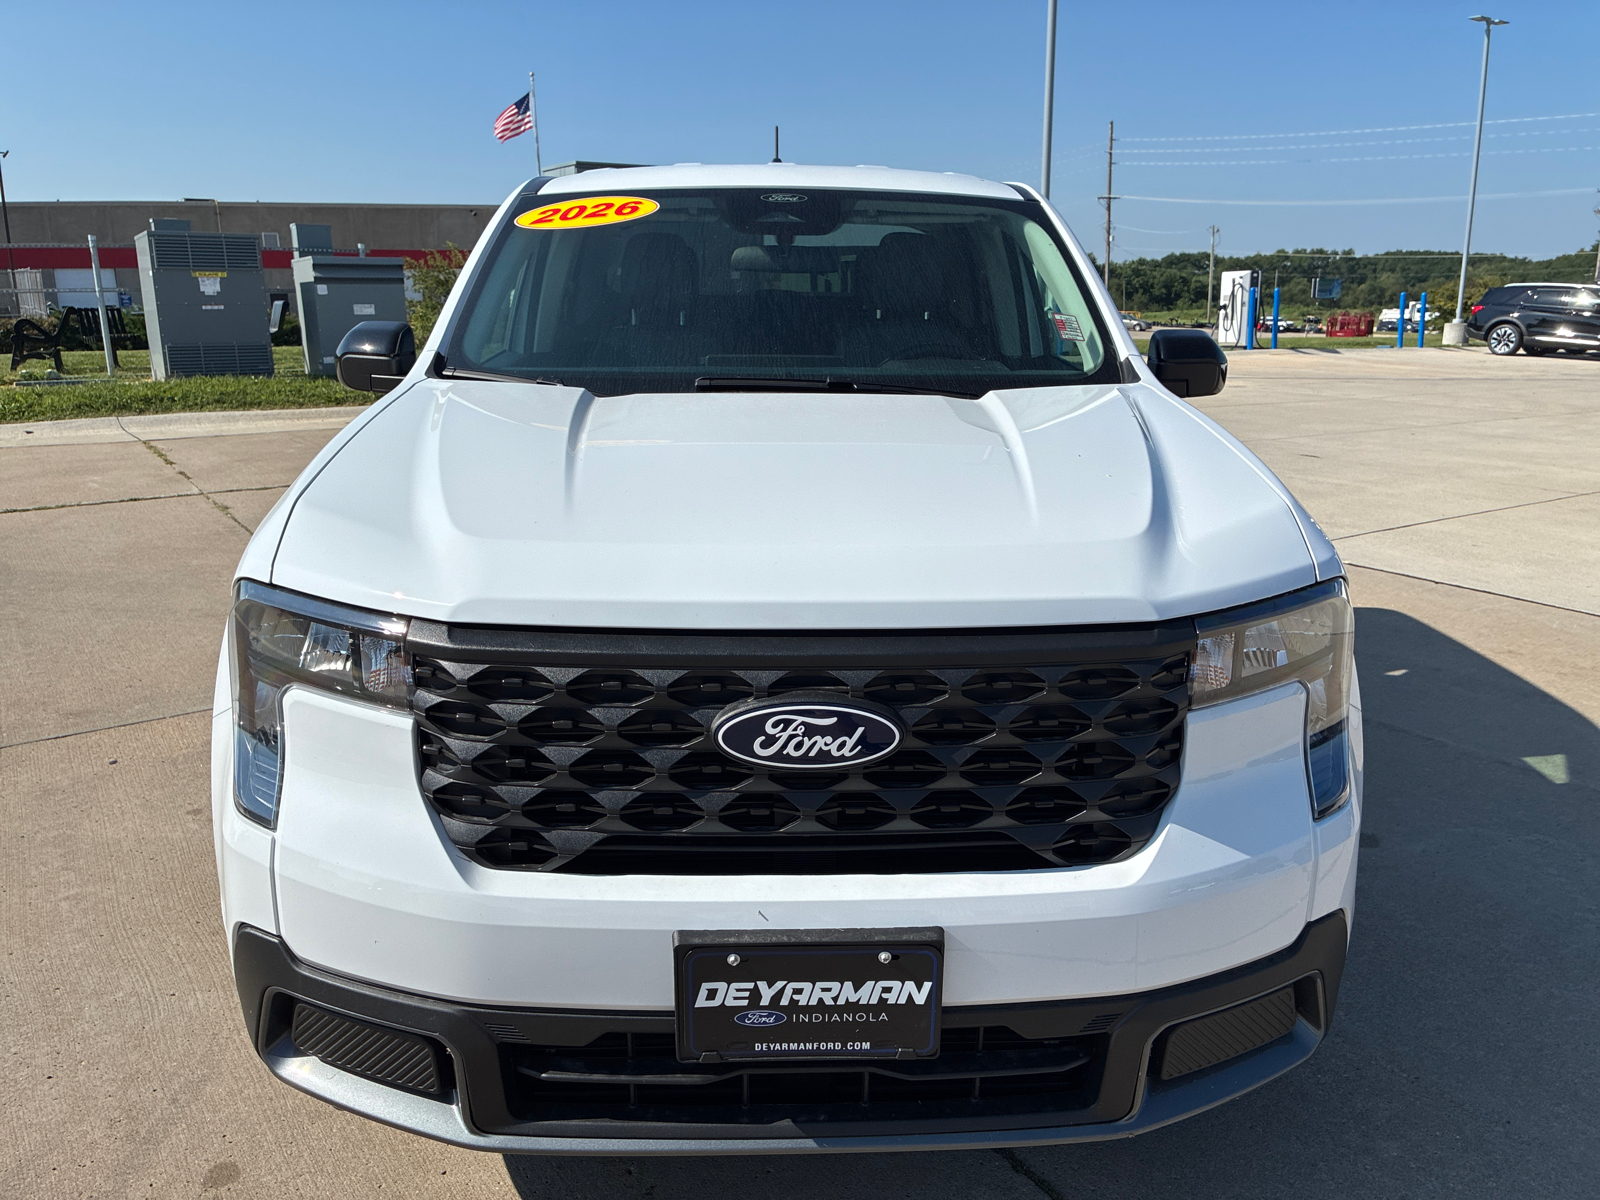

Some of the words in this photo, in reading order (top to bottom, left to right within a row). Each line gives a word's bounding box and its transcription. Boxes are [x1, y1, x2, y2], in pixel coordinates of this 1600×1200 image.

[528, 201, 643, 226] 2026
[753, 714, 865, 757] Ford
[694, 980, 933, 1008] DEYARMAN
[744, 1012, 777, 1025] Ford
[792, 1012, 889, 1023] INDIANOLA
[754, 1041, 871, 1051] DEYARMANFORD.COM
